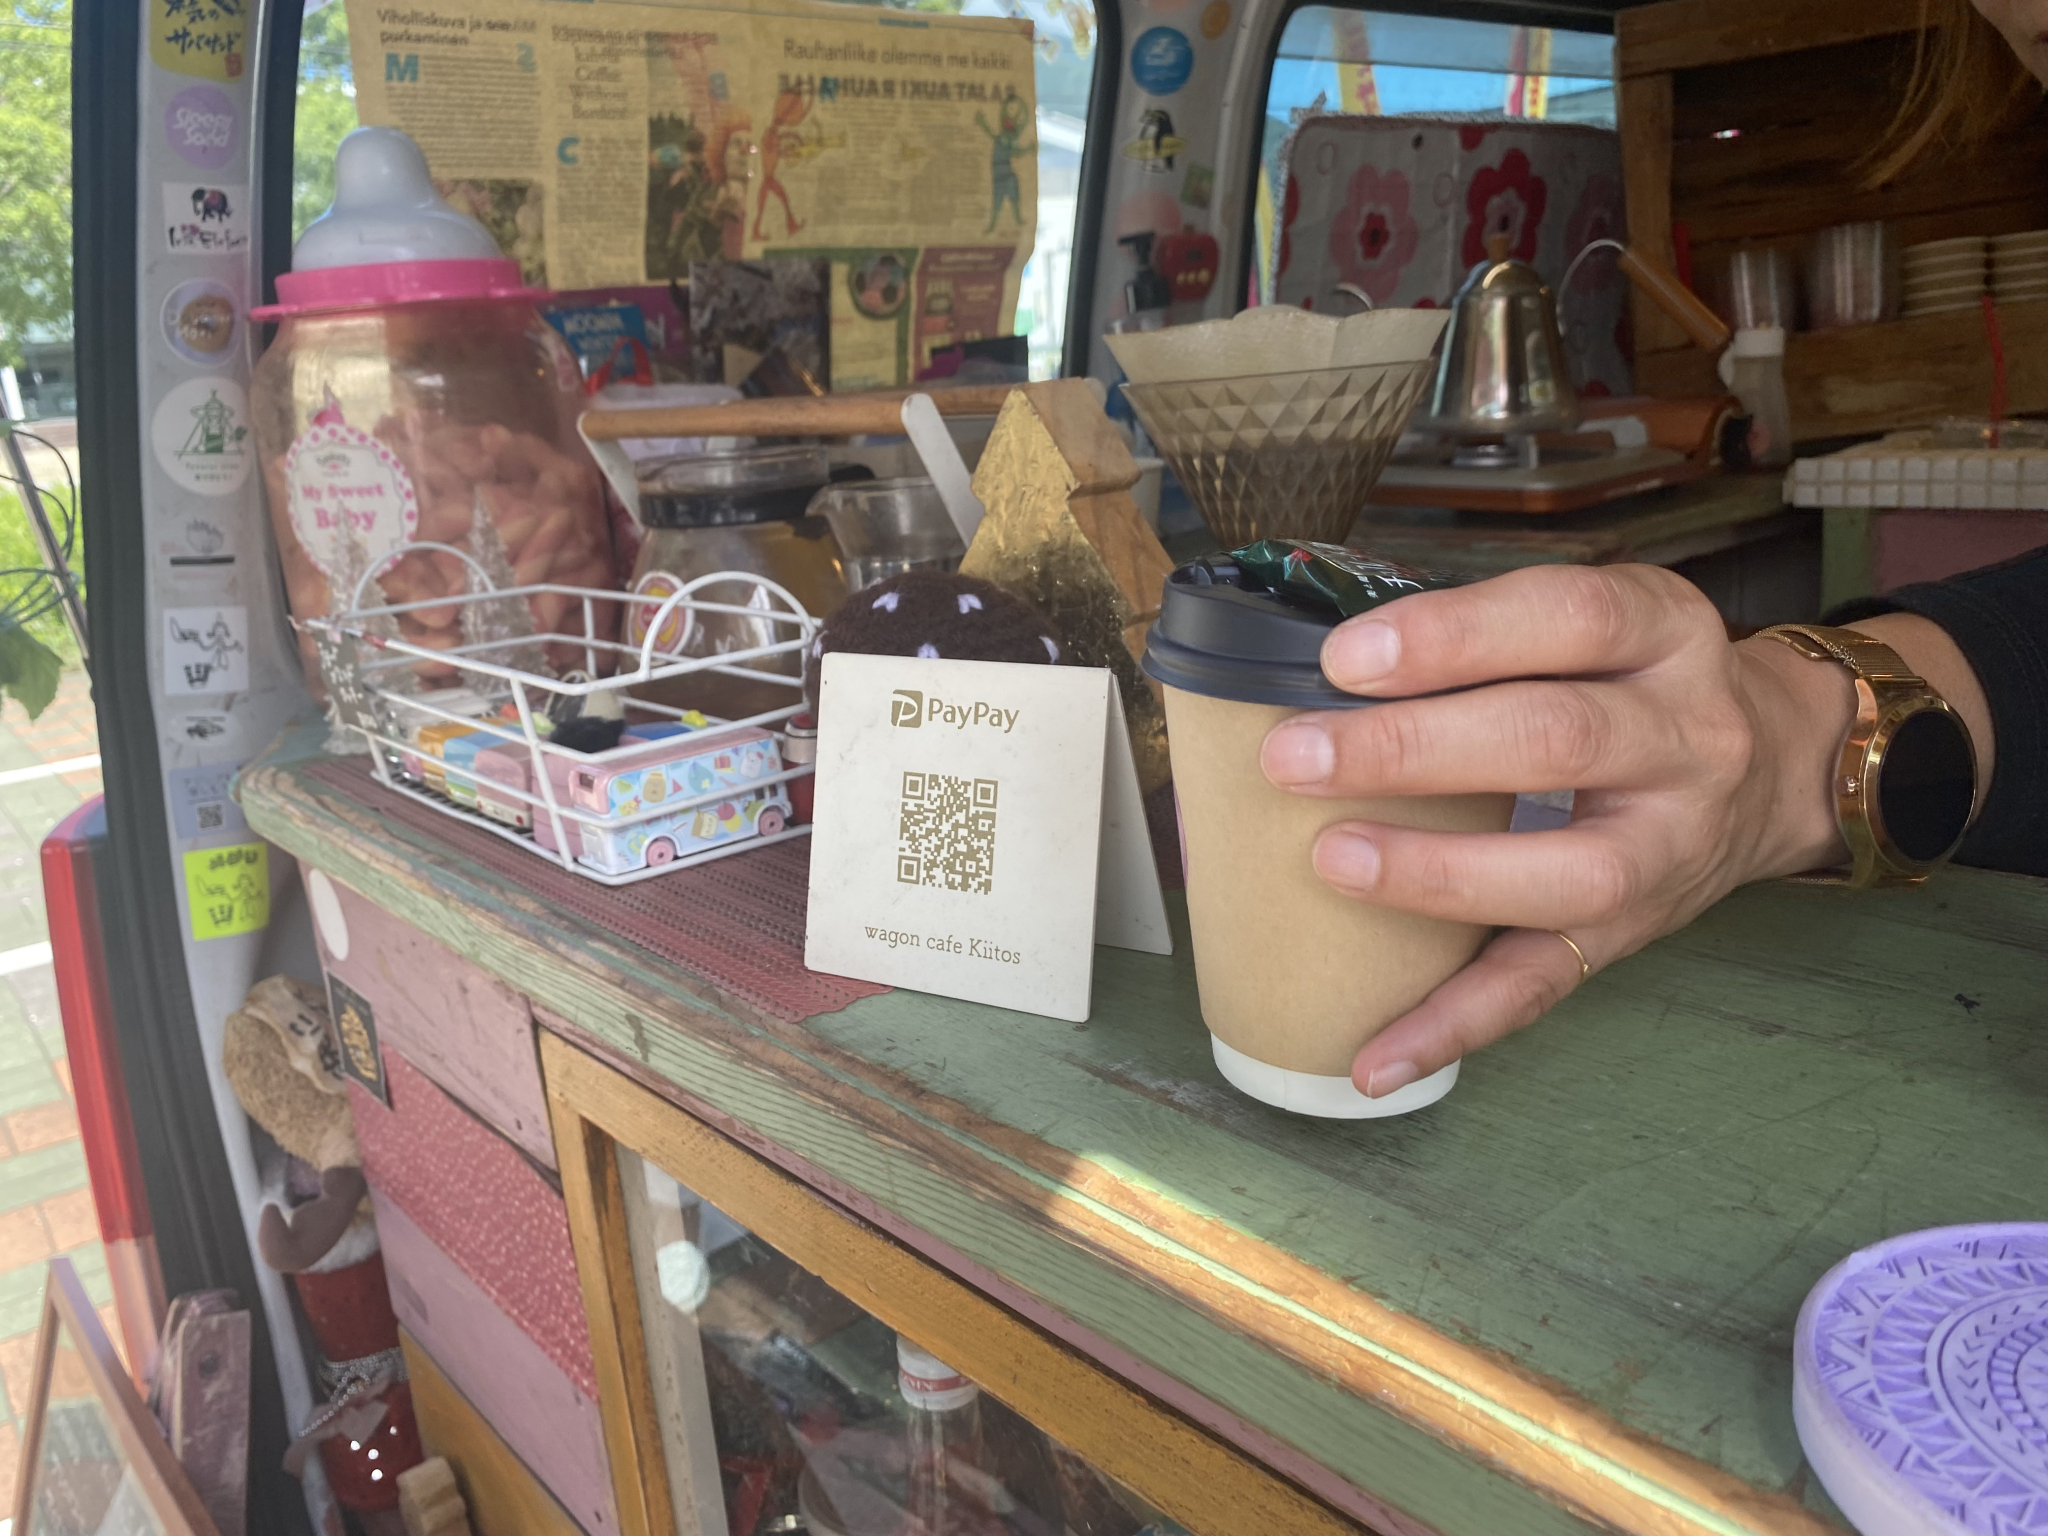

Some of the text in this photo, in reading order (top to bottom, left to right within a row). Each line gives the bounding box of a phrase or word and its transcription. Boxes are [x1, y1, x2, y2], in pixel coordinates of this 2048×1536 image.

[928, 699, 1019, 733] PayPay
[864, 927, 1020, 964] wagon cafe Kiitos
